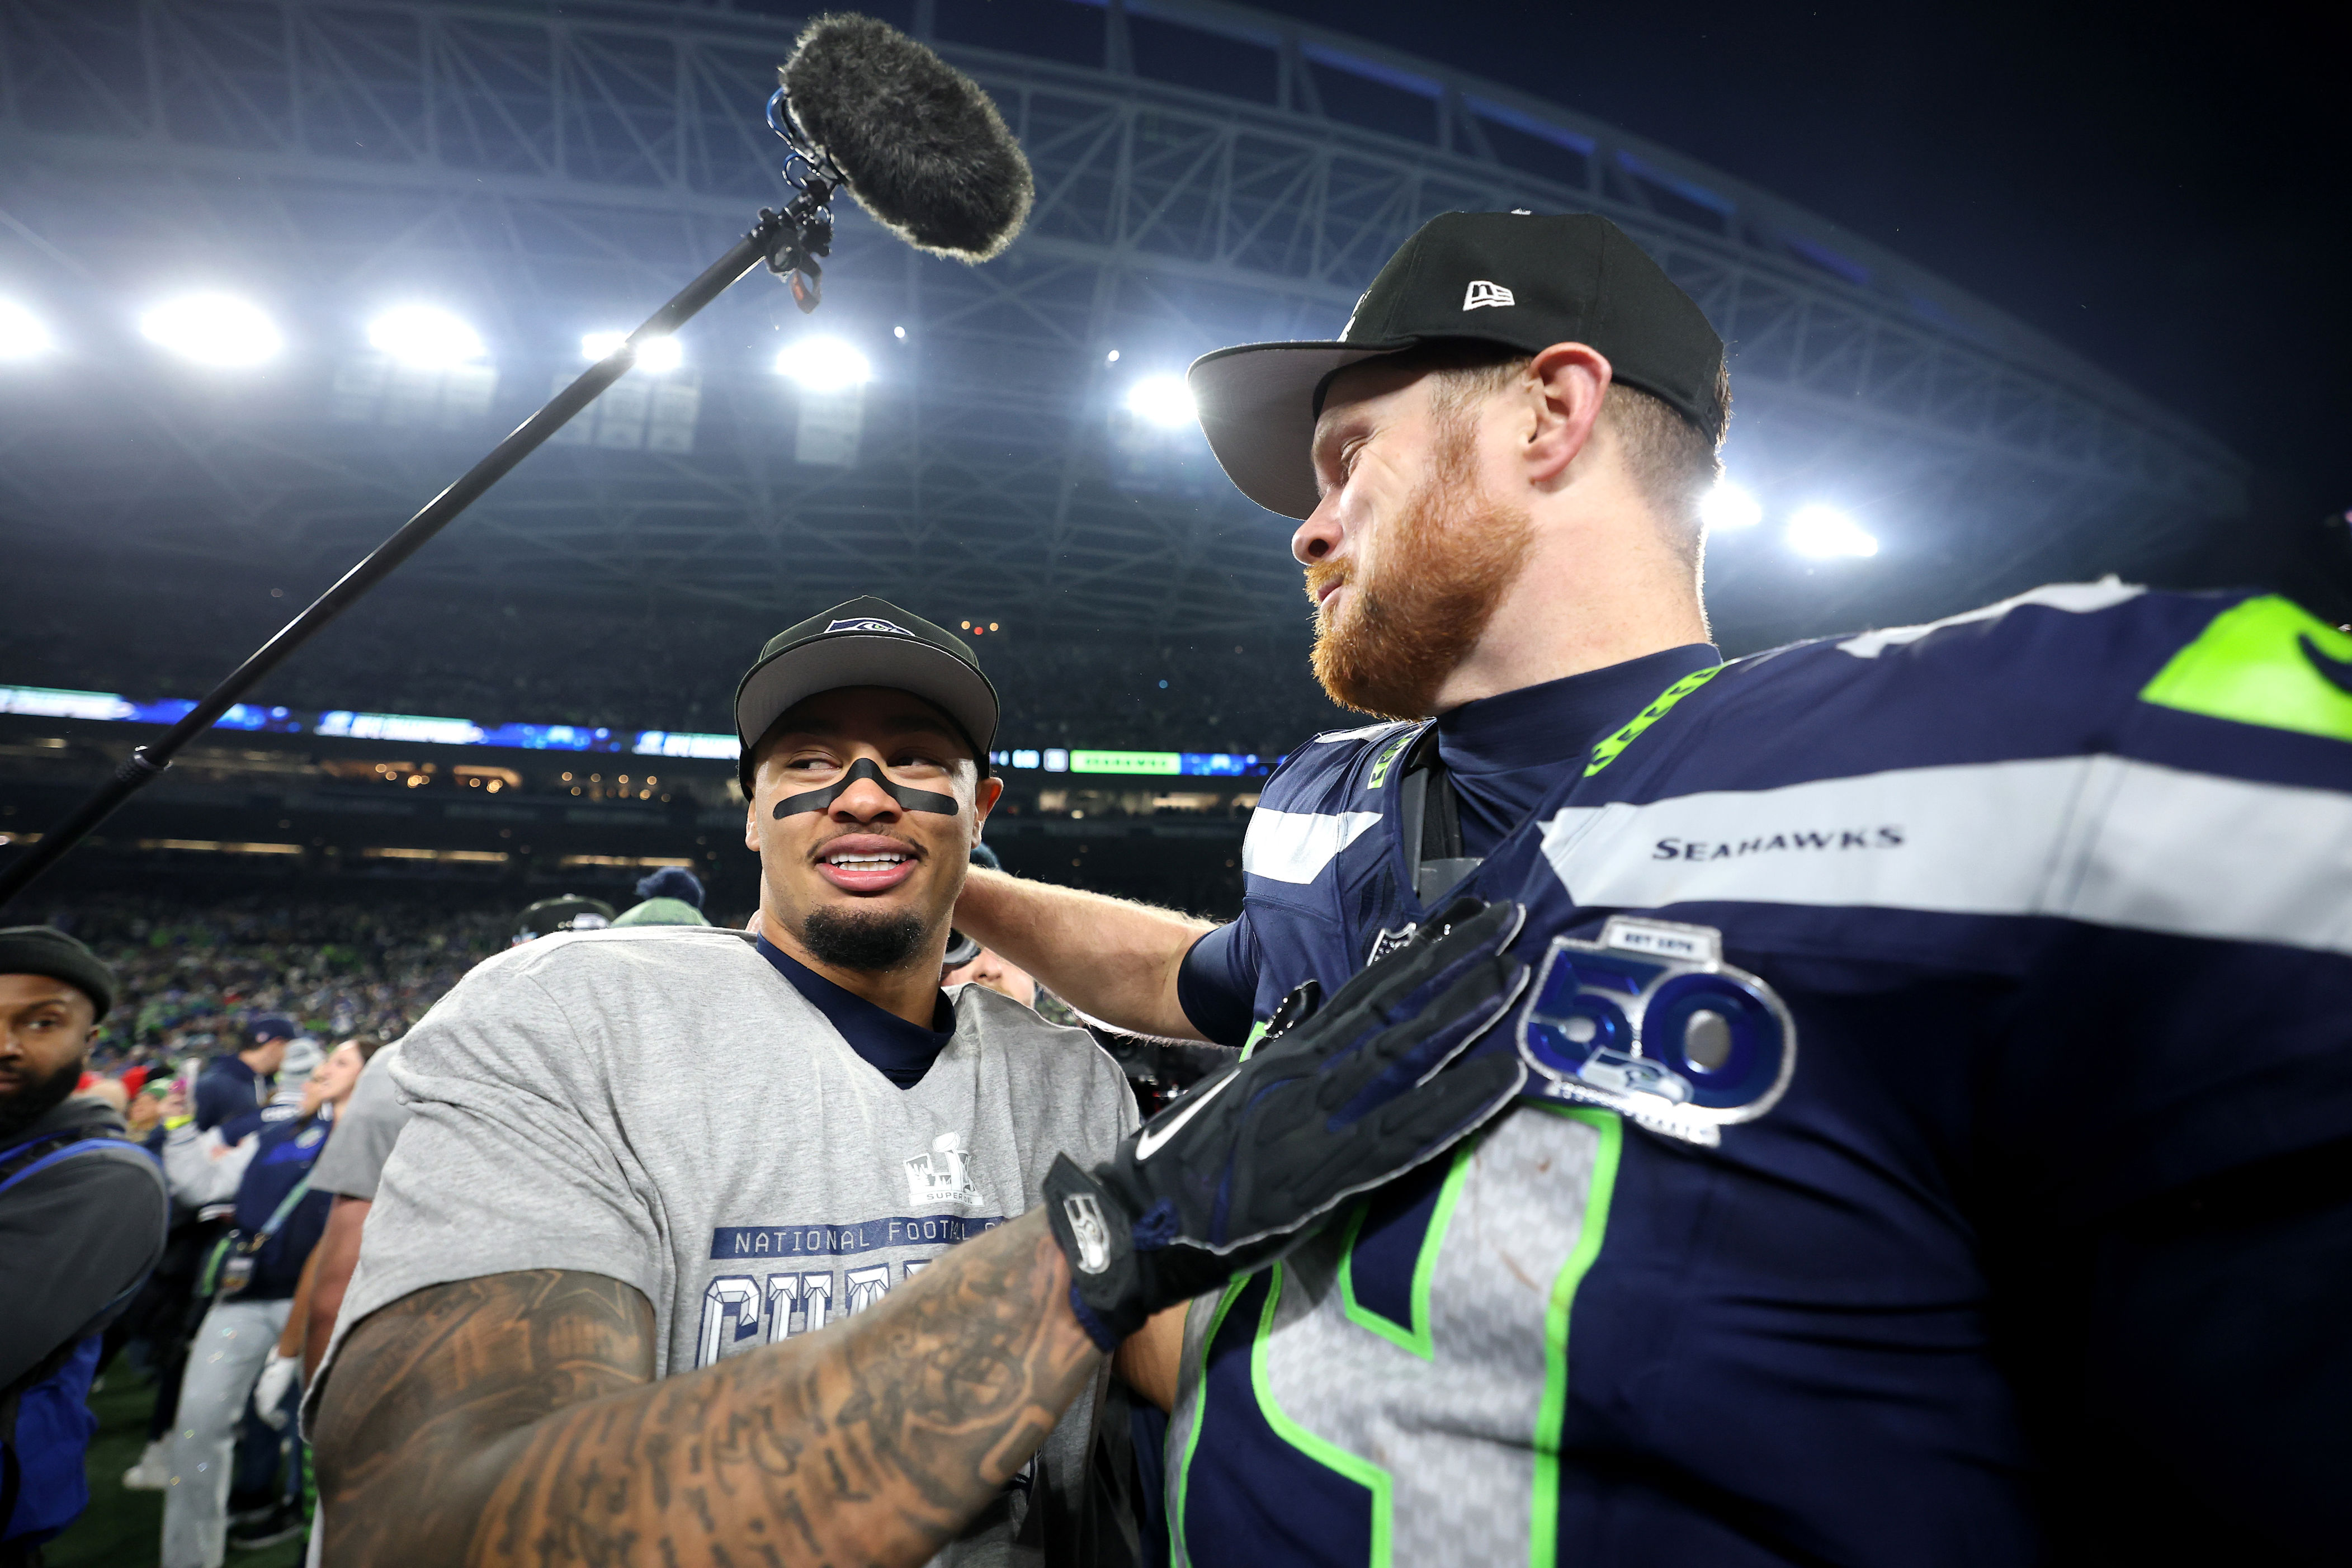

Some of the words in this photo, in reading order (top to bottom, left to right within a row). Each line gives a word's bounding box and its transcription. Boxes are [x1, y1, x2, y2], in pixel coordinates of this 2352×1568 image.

[1652, 824, 1905, 862] SEAHAWKS
[927, 1192, 963, 1200] SUPER
[734, 1228, 870, 1254] NATIONAL
